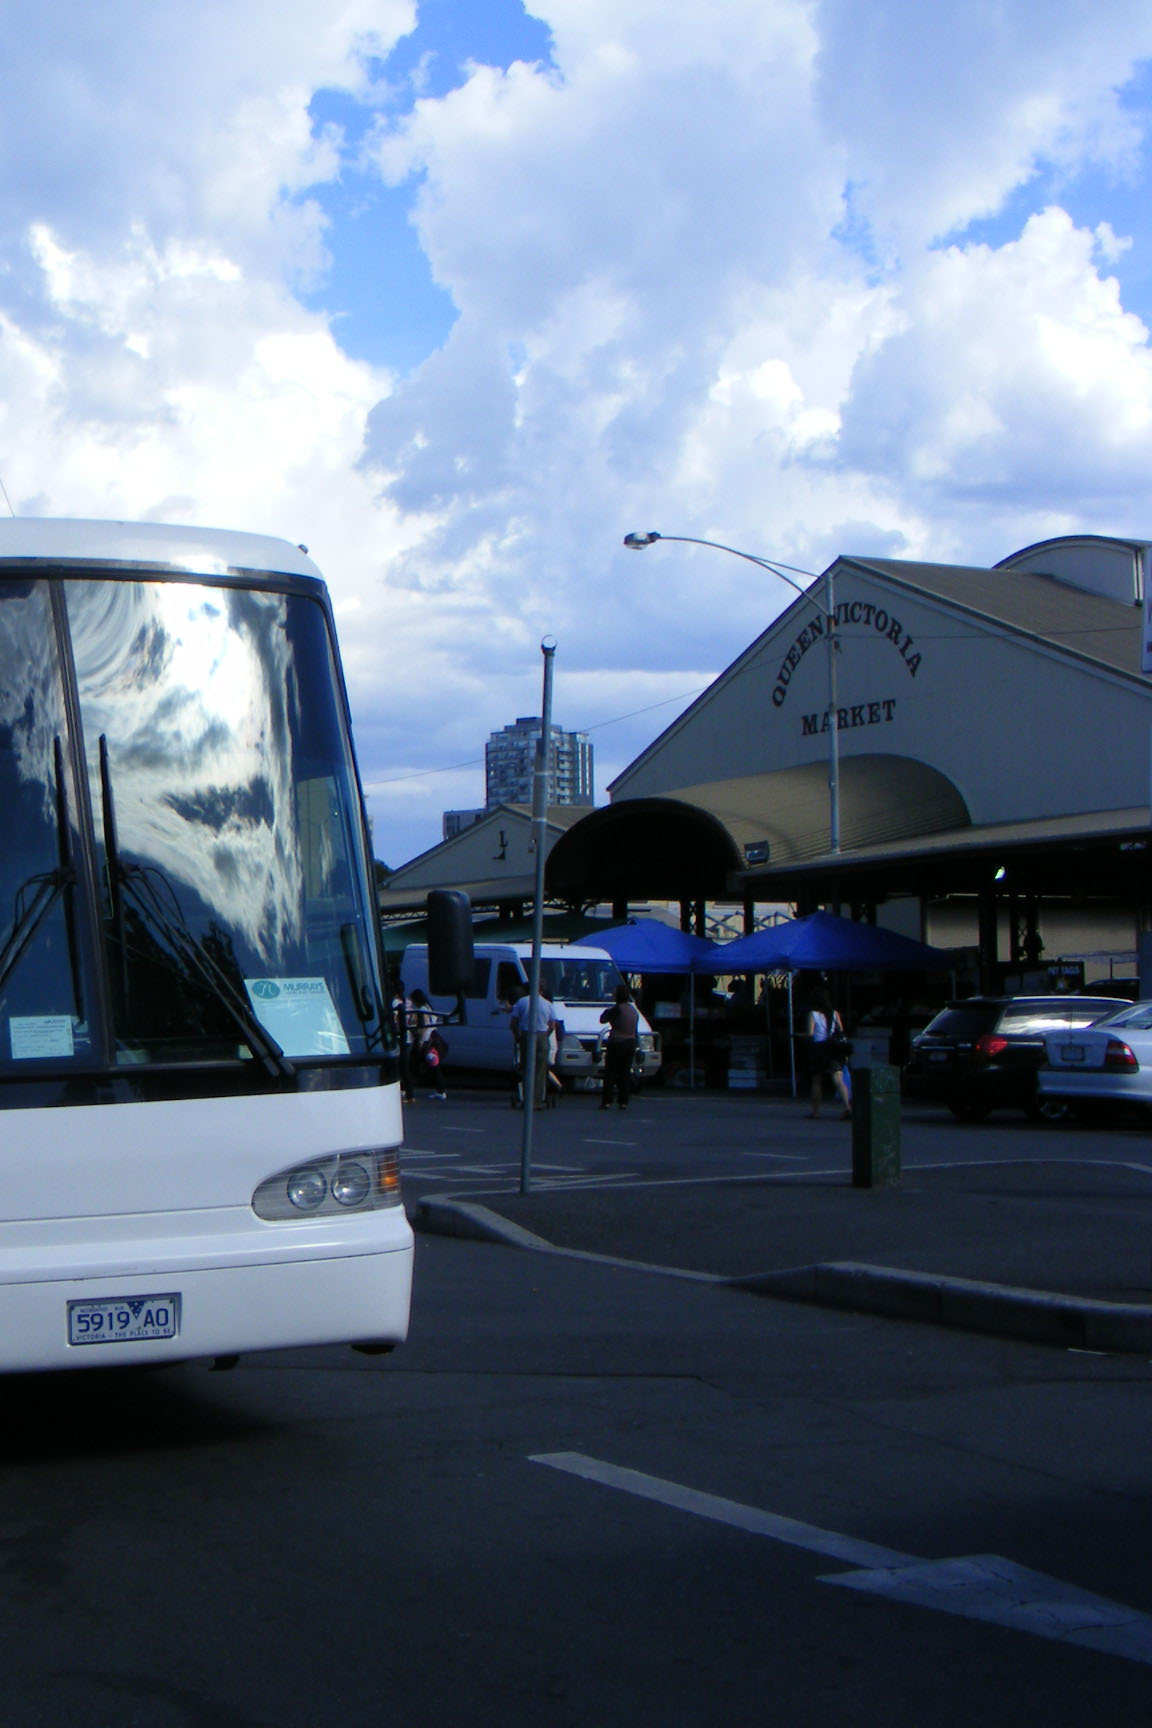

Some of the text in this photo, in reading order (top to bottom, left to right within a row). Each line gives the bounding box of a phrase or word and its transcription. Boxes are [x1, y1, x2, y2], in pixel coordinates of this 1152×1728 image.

[772, 601, 923, 707] QUEEN VICTORIA
[801, 699, 896, 736] MARKET
[283, 983, 325, 991] MURRAYS
[77, 1308, 169, 1332] 5919 AO
[76, 1333, 106, 1341] VICTORIA
[130, 1329, 149, 1337] PLACE
